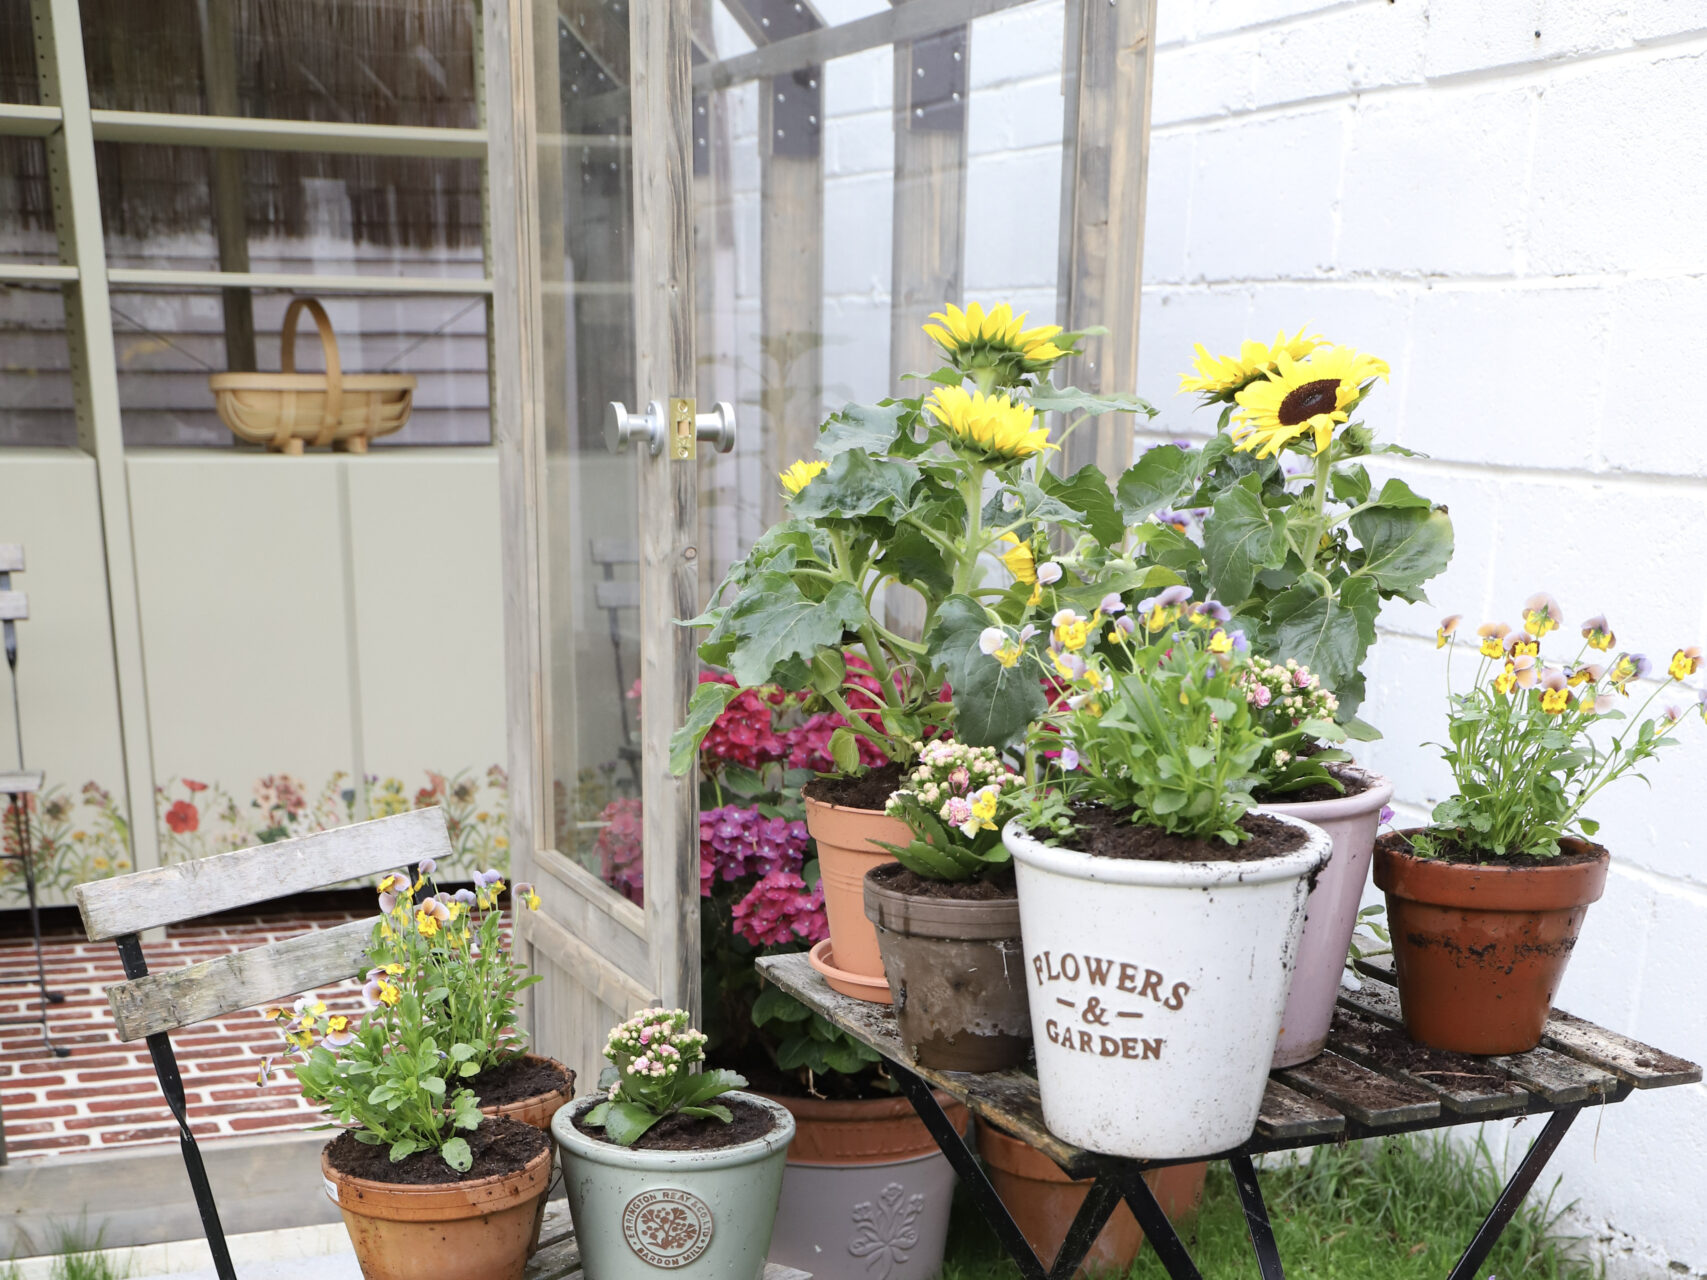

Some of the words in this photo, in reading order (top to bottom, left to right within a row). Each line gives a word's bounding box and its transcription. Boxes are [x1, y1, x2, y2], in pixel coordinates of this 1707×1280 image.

[1032, 951, 1190, 1011] FLOWERS
[1046, 1019, 1163, 1060] GARDEN
[626, 1193, 657, 1239] ERRINGTON
[662, 1192, 691, 1203] REAY
[637, 1247, 680, 1266] BARDON
[682, 1245, 704, 1262] MILL
